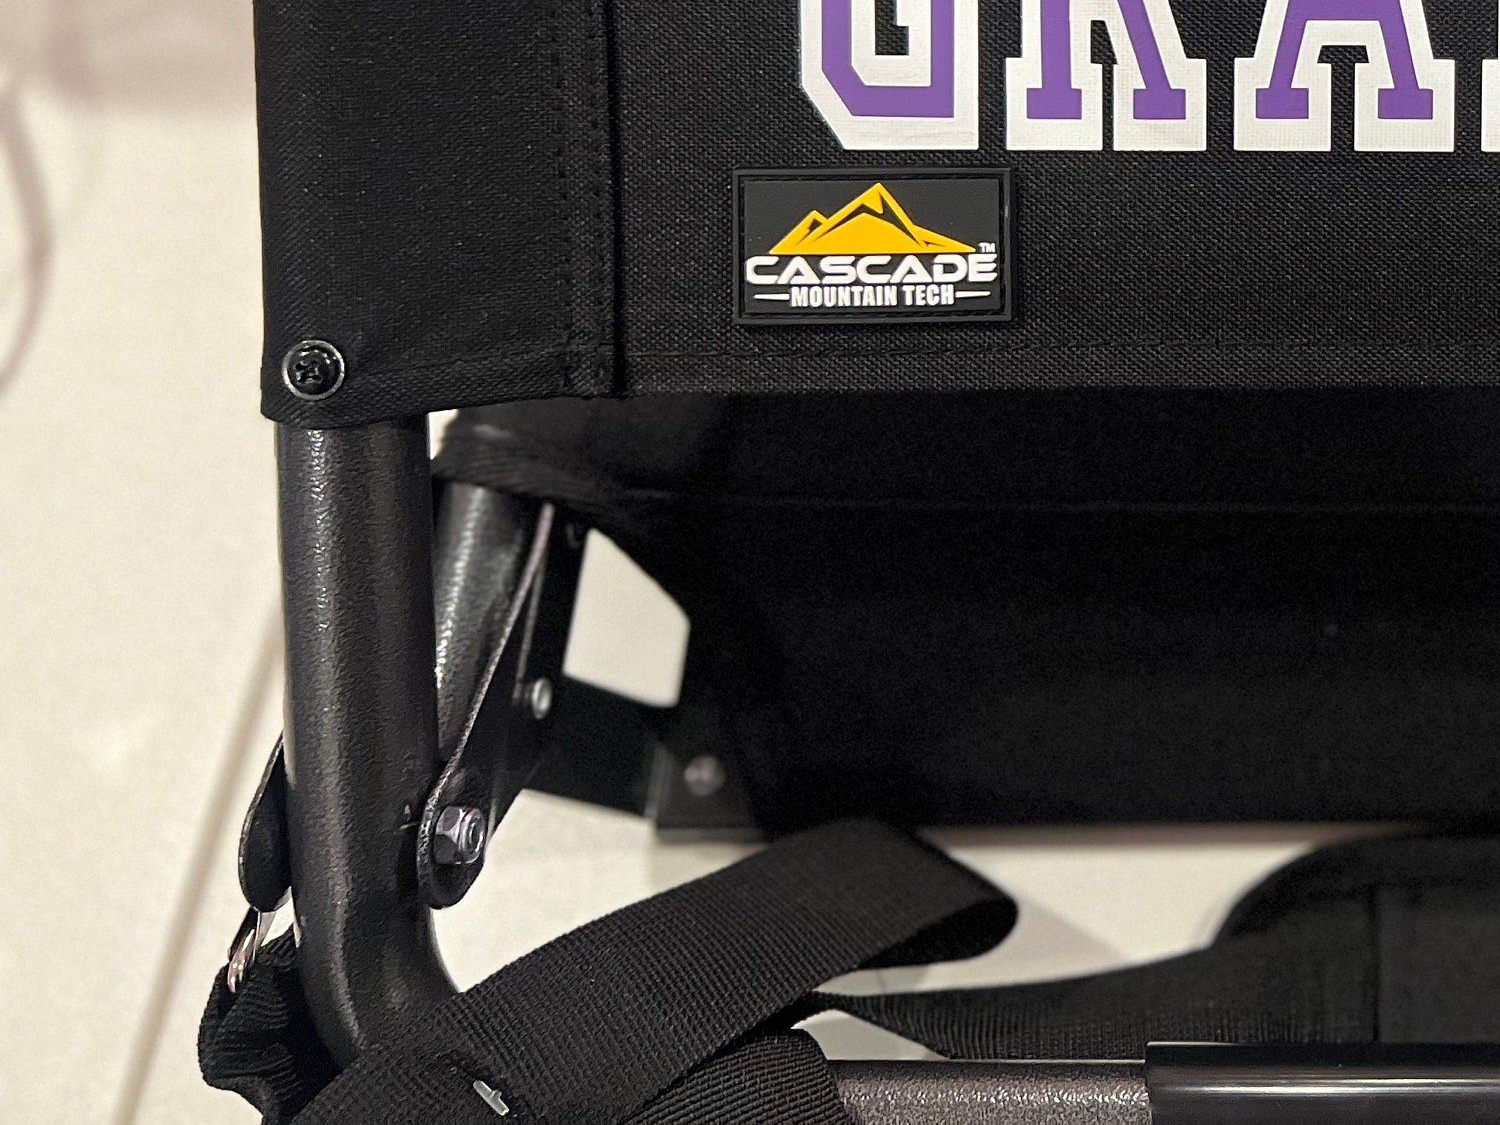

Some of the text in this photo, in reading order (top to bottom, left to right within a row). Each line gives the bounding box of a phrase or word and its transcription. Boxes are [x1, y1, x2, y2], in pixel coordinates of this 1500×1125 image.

[746, 254, 998, 284] CASCADE
[790, 284, 954, 308] MOUNTAIN TECH
